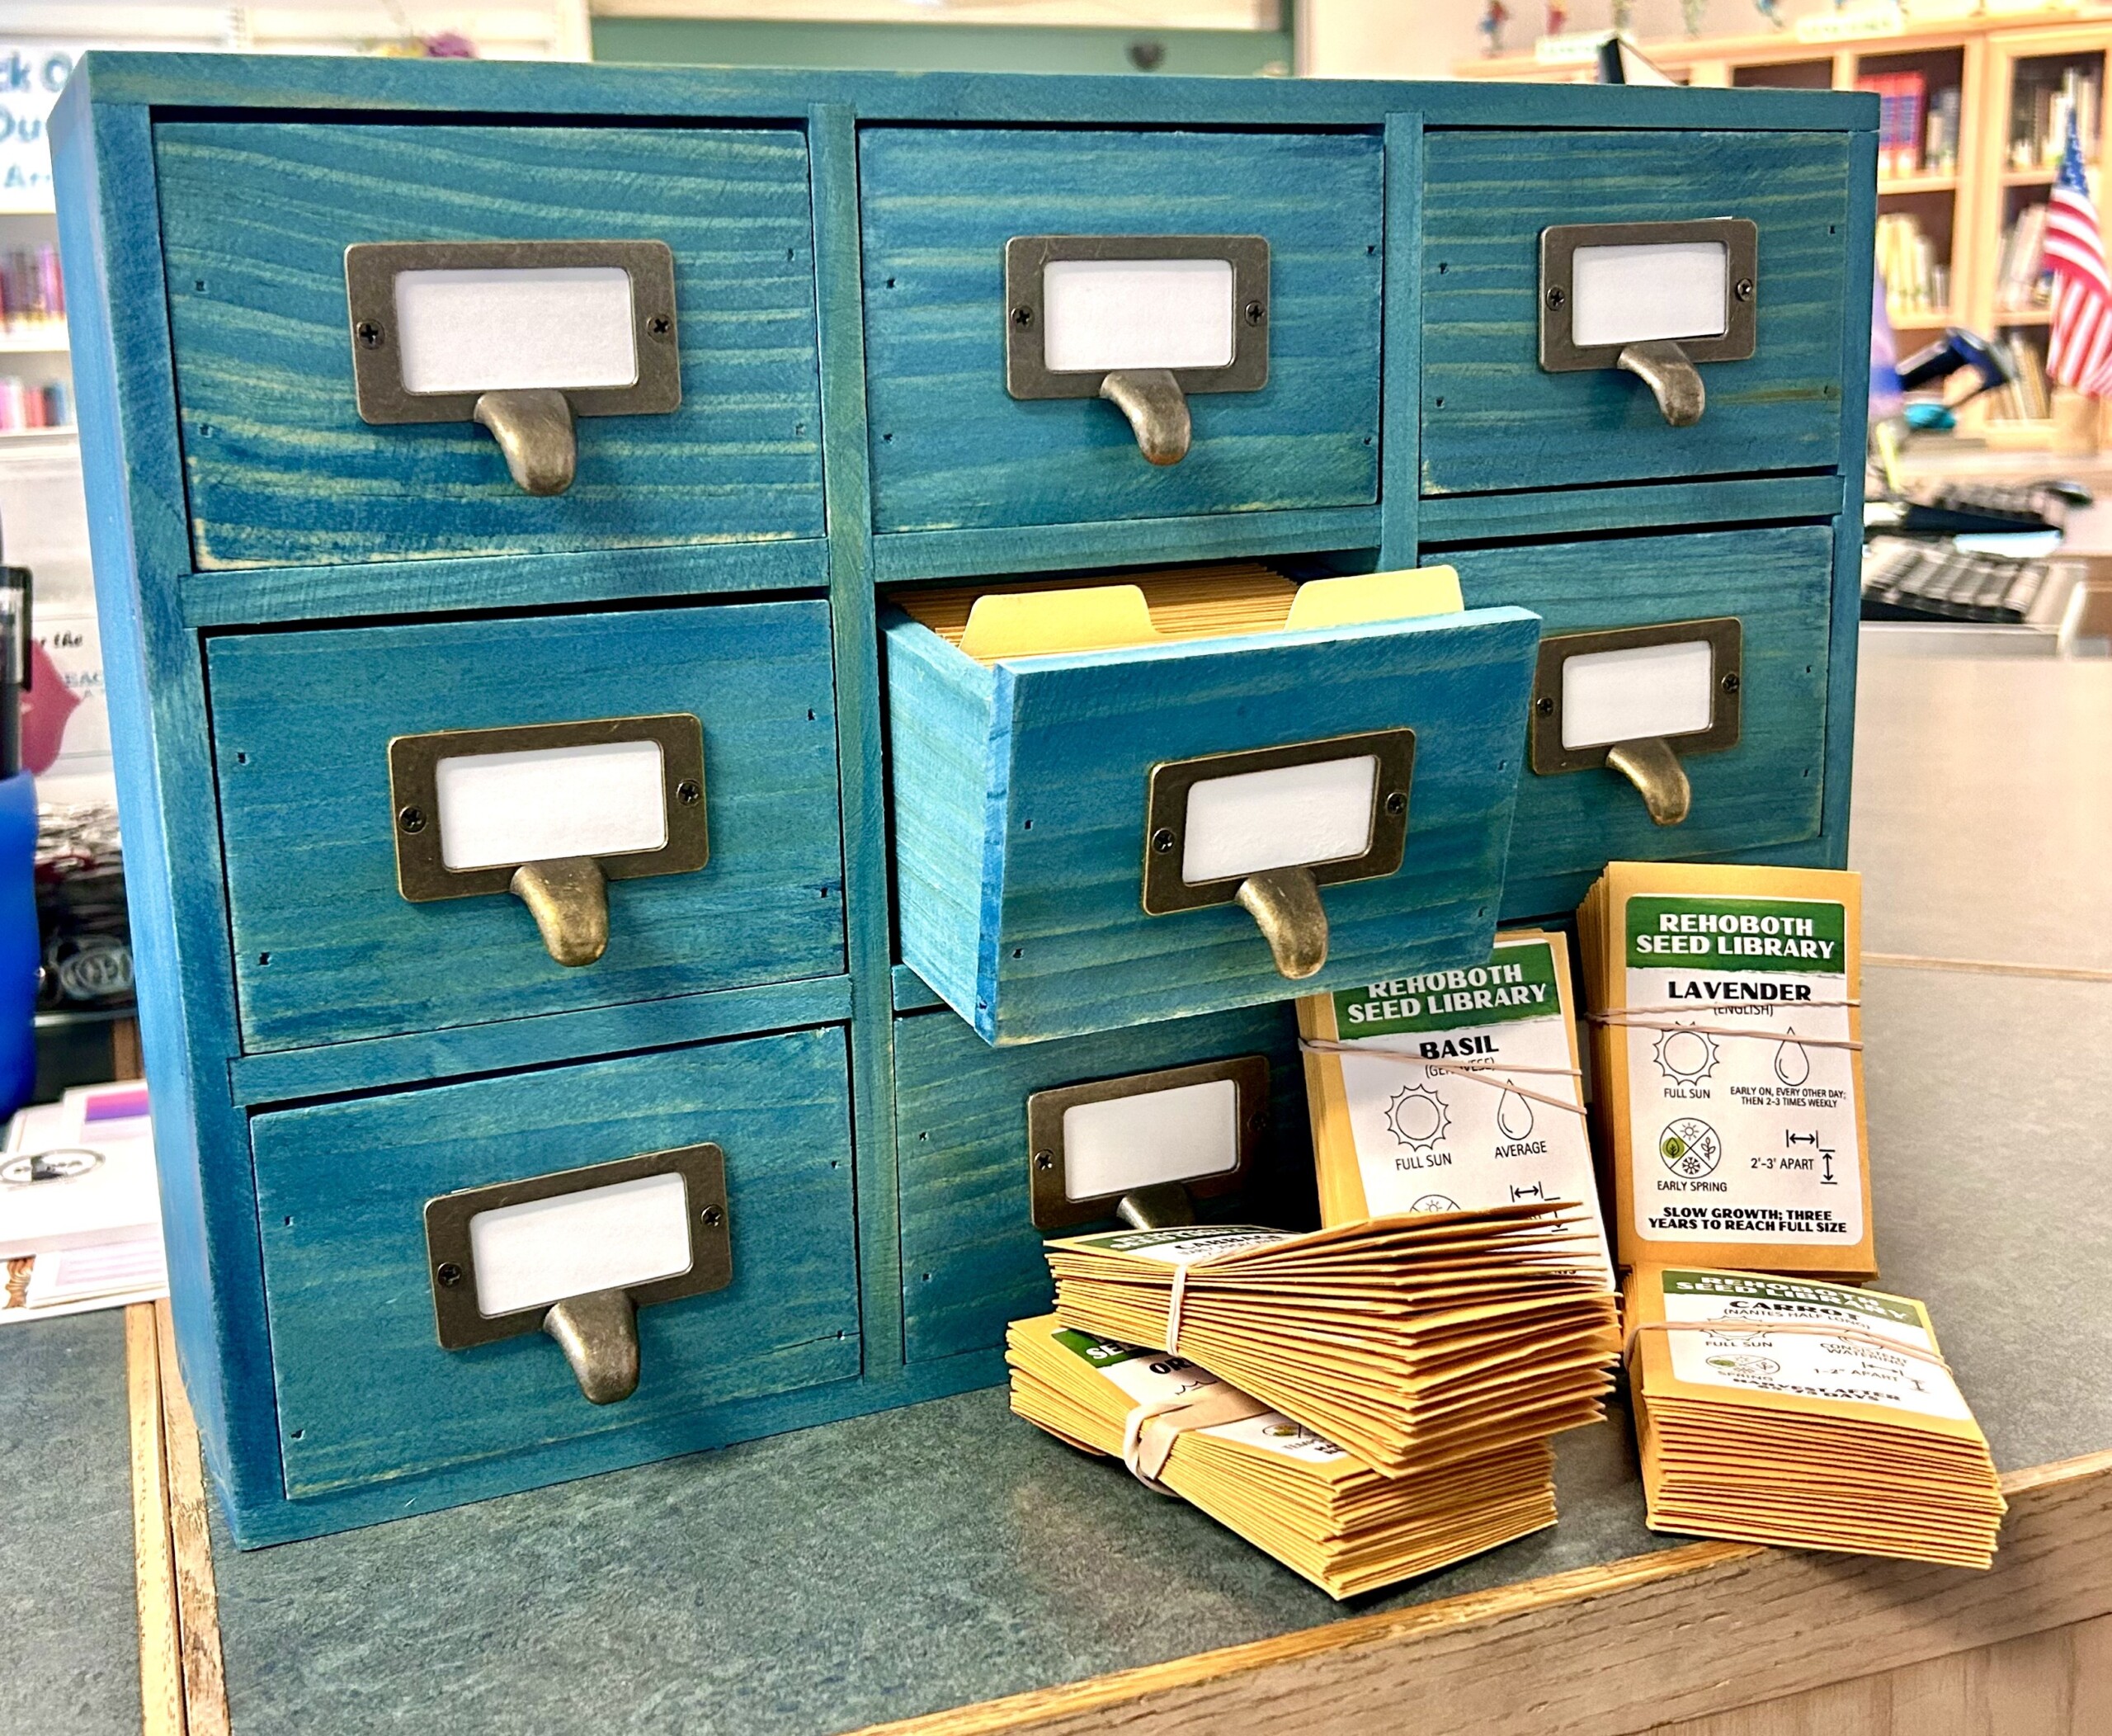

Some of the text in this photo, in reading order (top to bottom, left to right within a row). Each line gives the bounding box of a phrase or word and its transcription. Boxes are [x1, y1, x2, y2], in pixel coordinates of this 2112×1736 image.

[1659, 913, 1813, 936] REHOBOTH
[1636, 934, 1834, 959] SEED LIBRARY
[1368, 964, 1523, 998] REHOBOTH
[1668, 980, 1812, 1001] LAVENDER
[1347, 983, 1547, 1024] SEED LIBRARY
[1419, 1035, 1500, 1060] BASIL
[1663, 1087, 1711, 1099] FULL SUN
[1730, 1086, 1756, 1096] EARLY
[1759, 1087, 1775, 1097] ON,
[1776, 1087, 1801, 1097] EVERY
[1802, 1087, 1827, 1098] OTHER
[1742, 1097, 1838, 1108] THEN 2-3 TIMES WEEKLY
[1494, 1140, 1548, 1159] AVERAGE
[1395, 1153, 1453, 1171] FULL SUN
[1779, 1158, 1814, 1170] APART
[1657, 1180, 1728, 1192] EARLY SPRING
[1663, 1206, 1833, 1221] SLOW GROWTH; THREE
[1648, 1217, 1847, 1234] YEARS TO REACH FULL SIZE
[1676, 1281, 1907, 1320] SEED LIBRARY
[1700, 1276, 1879, 1307] REHOBOTH
[1723, 1308, 1784, 1318] (NANTES
[1729, 1300, 1859, 1321] CARROT
[1851, 1370, 1898, 1382] APART
